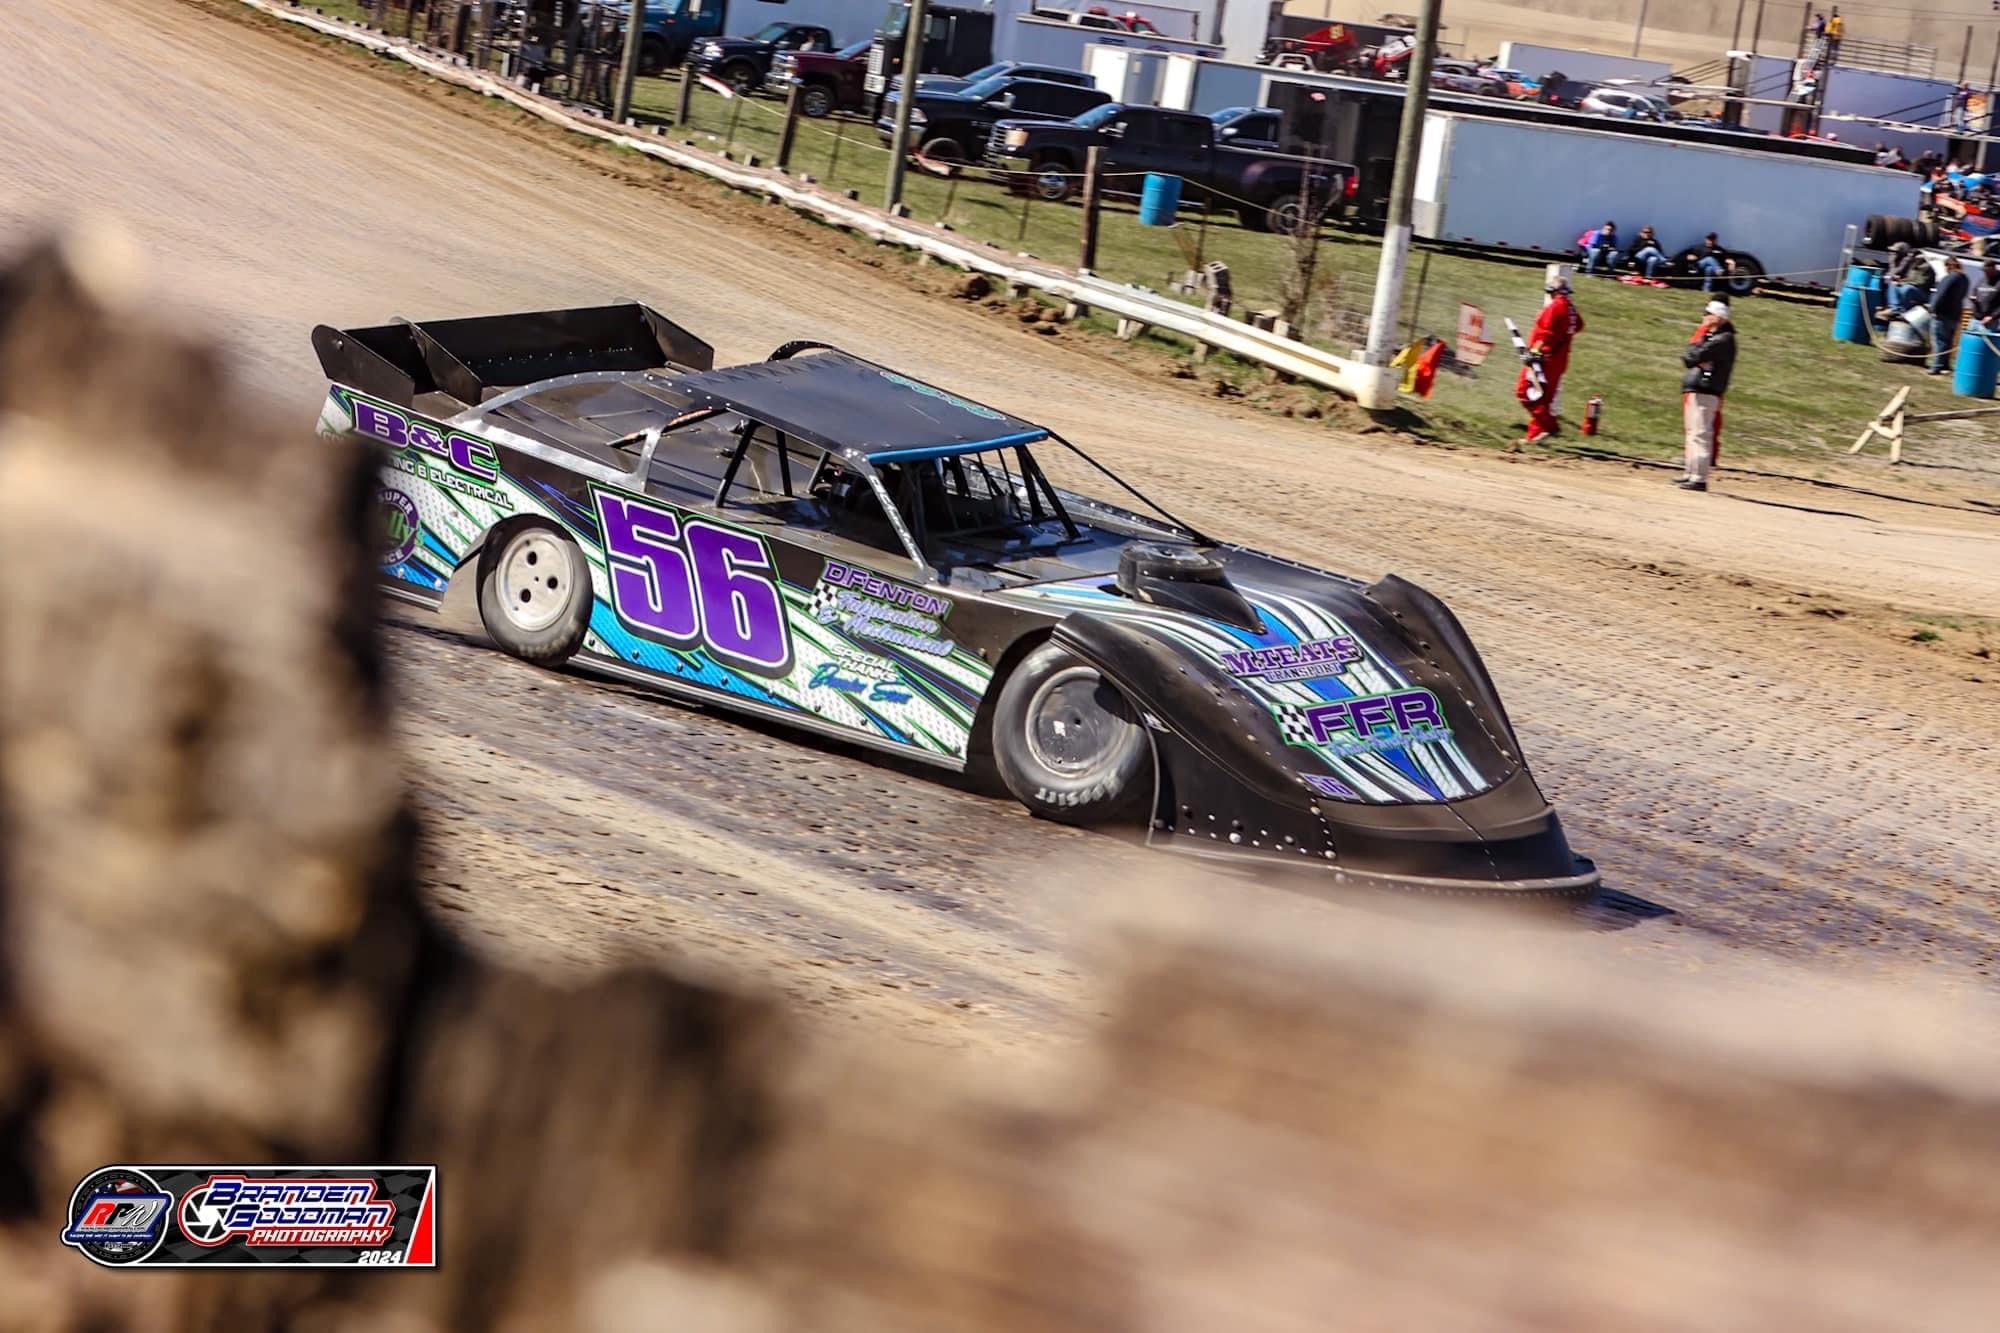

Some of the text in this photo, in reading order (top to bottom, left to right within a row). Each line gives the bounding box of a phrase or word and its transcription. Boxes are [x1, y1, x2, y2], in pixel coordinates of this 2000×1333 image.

[350, 398, 497, 482] B&C
[389, 455, 415, 473] ING
[430, 469, 514, 510] ELECTRICAL
[592, 488, 789, 667] 56
[832, 645, 895, 672] SPECIAL
[840, 659, 897, 682] THANKS
[1264, 661, 1340, 681] TRANSPORT
[1304, 690, 1443, 746] FFR
